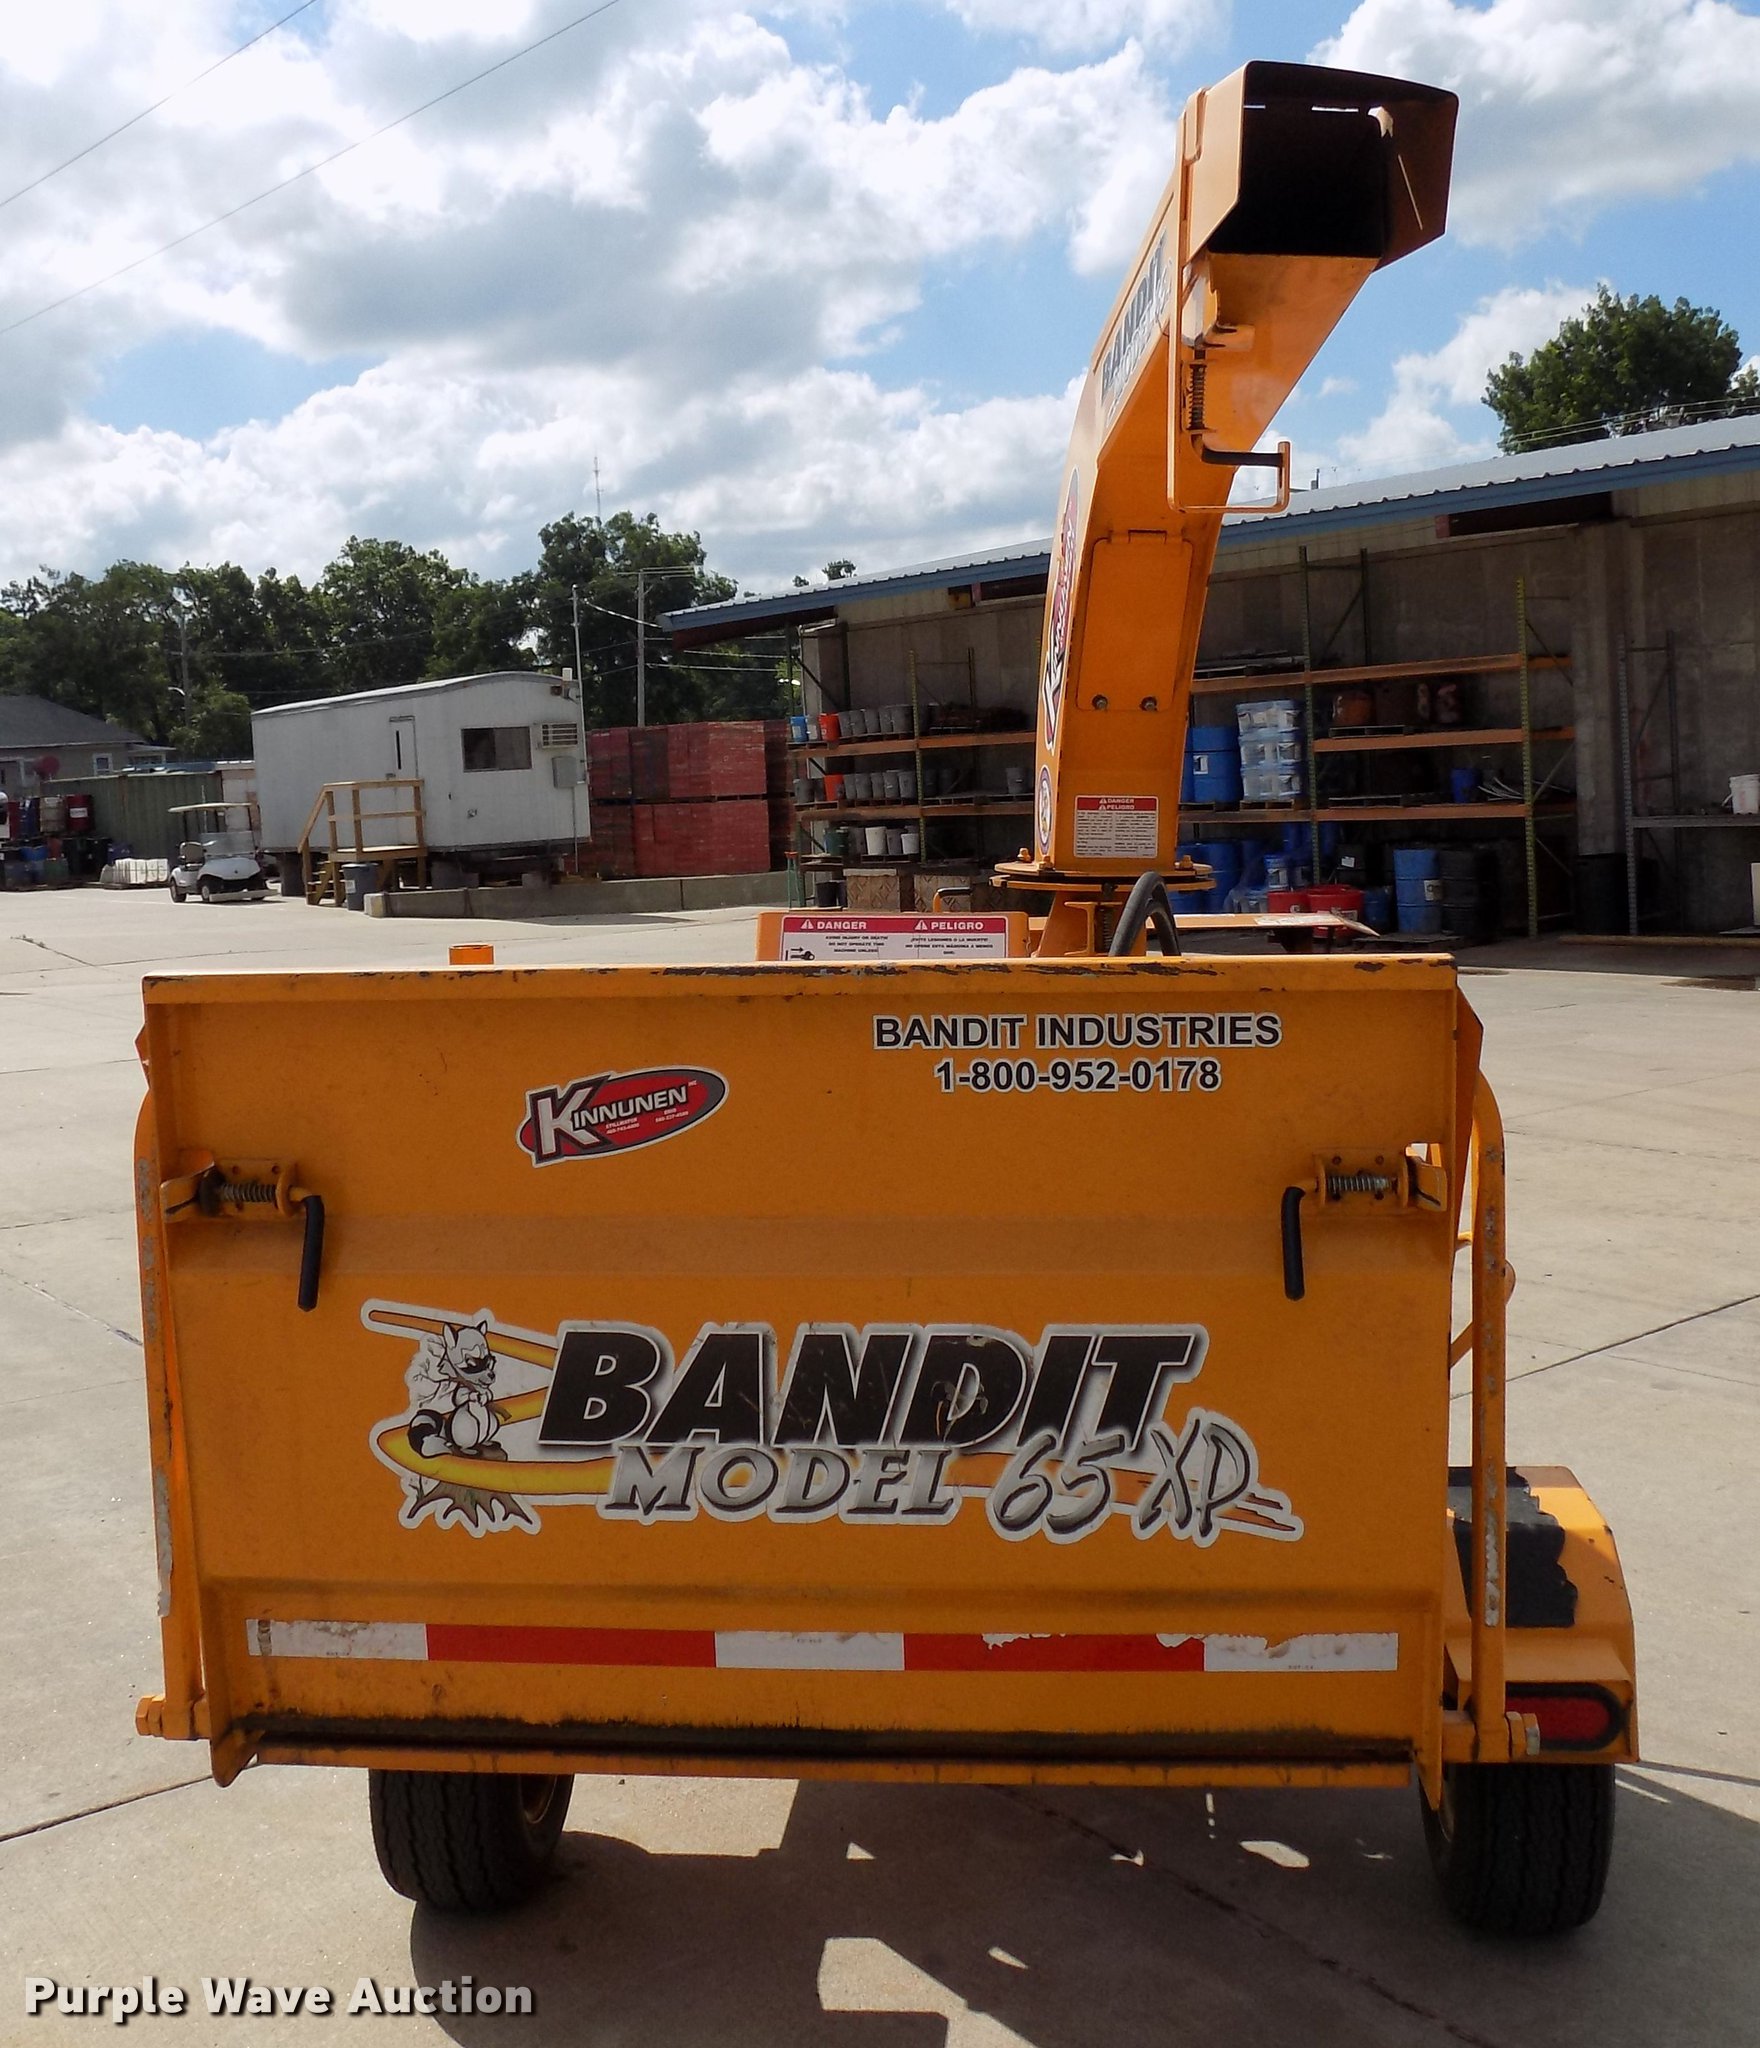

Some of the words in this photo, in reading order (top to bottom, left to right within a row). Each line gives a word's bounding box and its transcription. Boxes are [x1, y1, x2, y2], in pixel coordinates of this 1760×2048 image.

[1101, 229, 1166, 400] BANDIT
[816, 921, 867, 930] DANGER
[931, 921, 984, 930] PELIGRO
[874, 1015, 1025, 1048] BANDIT
[1036, 1014, 1281, 1047] INDUSTRIES
[935, 1059, 1221, 1092] 1-800-952-0178
[537, 1086, 688, 1156] KINNUNEN
[537, 1329, 1198, 1450] BANDIT
[603, 1445, 955, 1516] MODEL
[994, 1432, 1125, 1534] 65
[1136, 1417, 1251, 1538] XP
